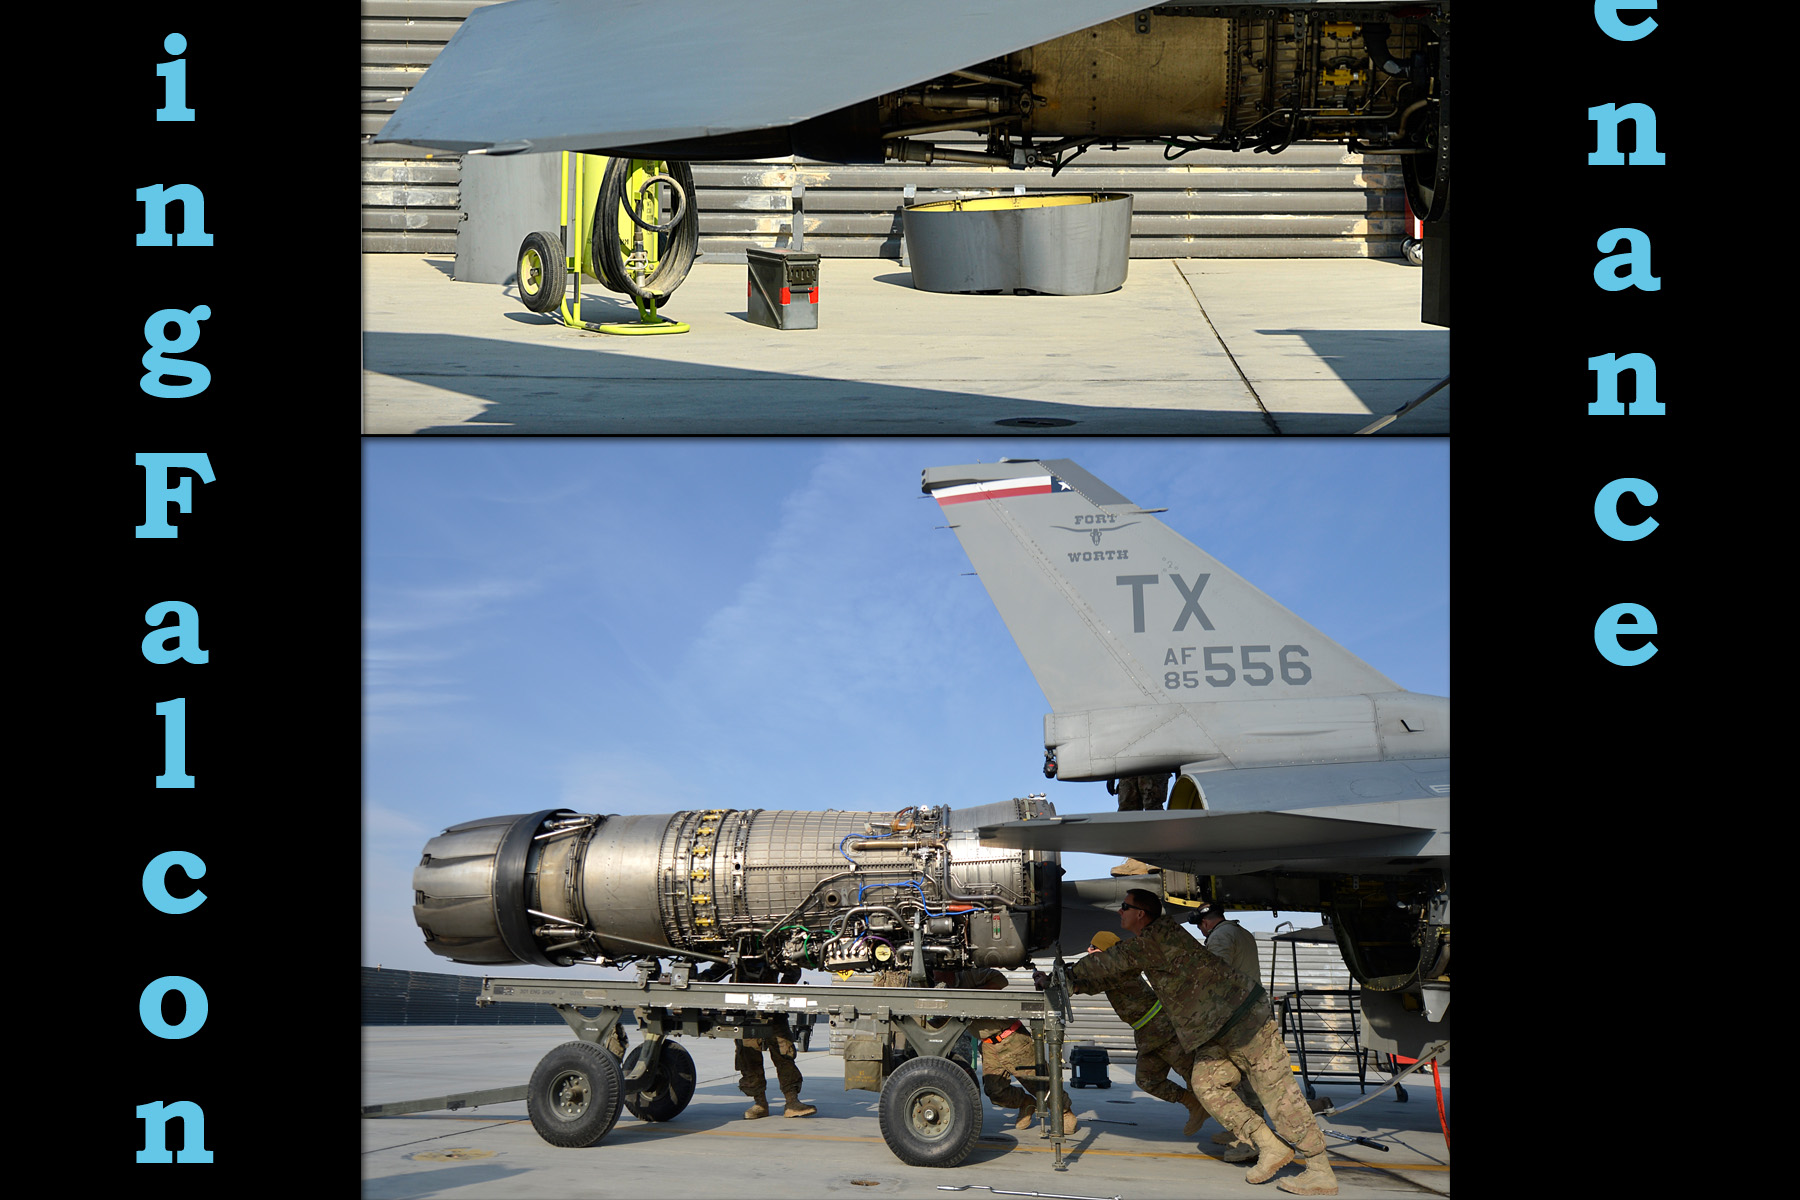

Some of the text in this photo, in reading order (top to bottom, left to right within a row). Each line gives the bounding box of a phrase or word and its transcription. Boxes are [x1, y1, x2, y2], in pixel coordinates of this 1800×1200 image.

[1074, 514, 1118, 525] FORT
[1067, 550, 1129, 563] WORTH
[1115, 573, 1216, 633] TX
[1163, 647, 1197, 666] AF
[1203, 645, 1312, 688] 556
[1164, 670, 1199, 690] 85
